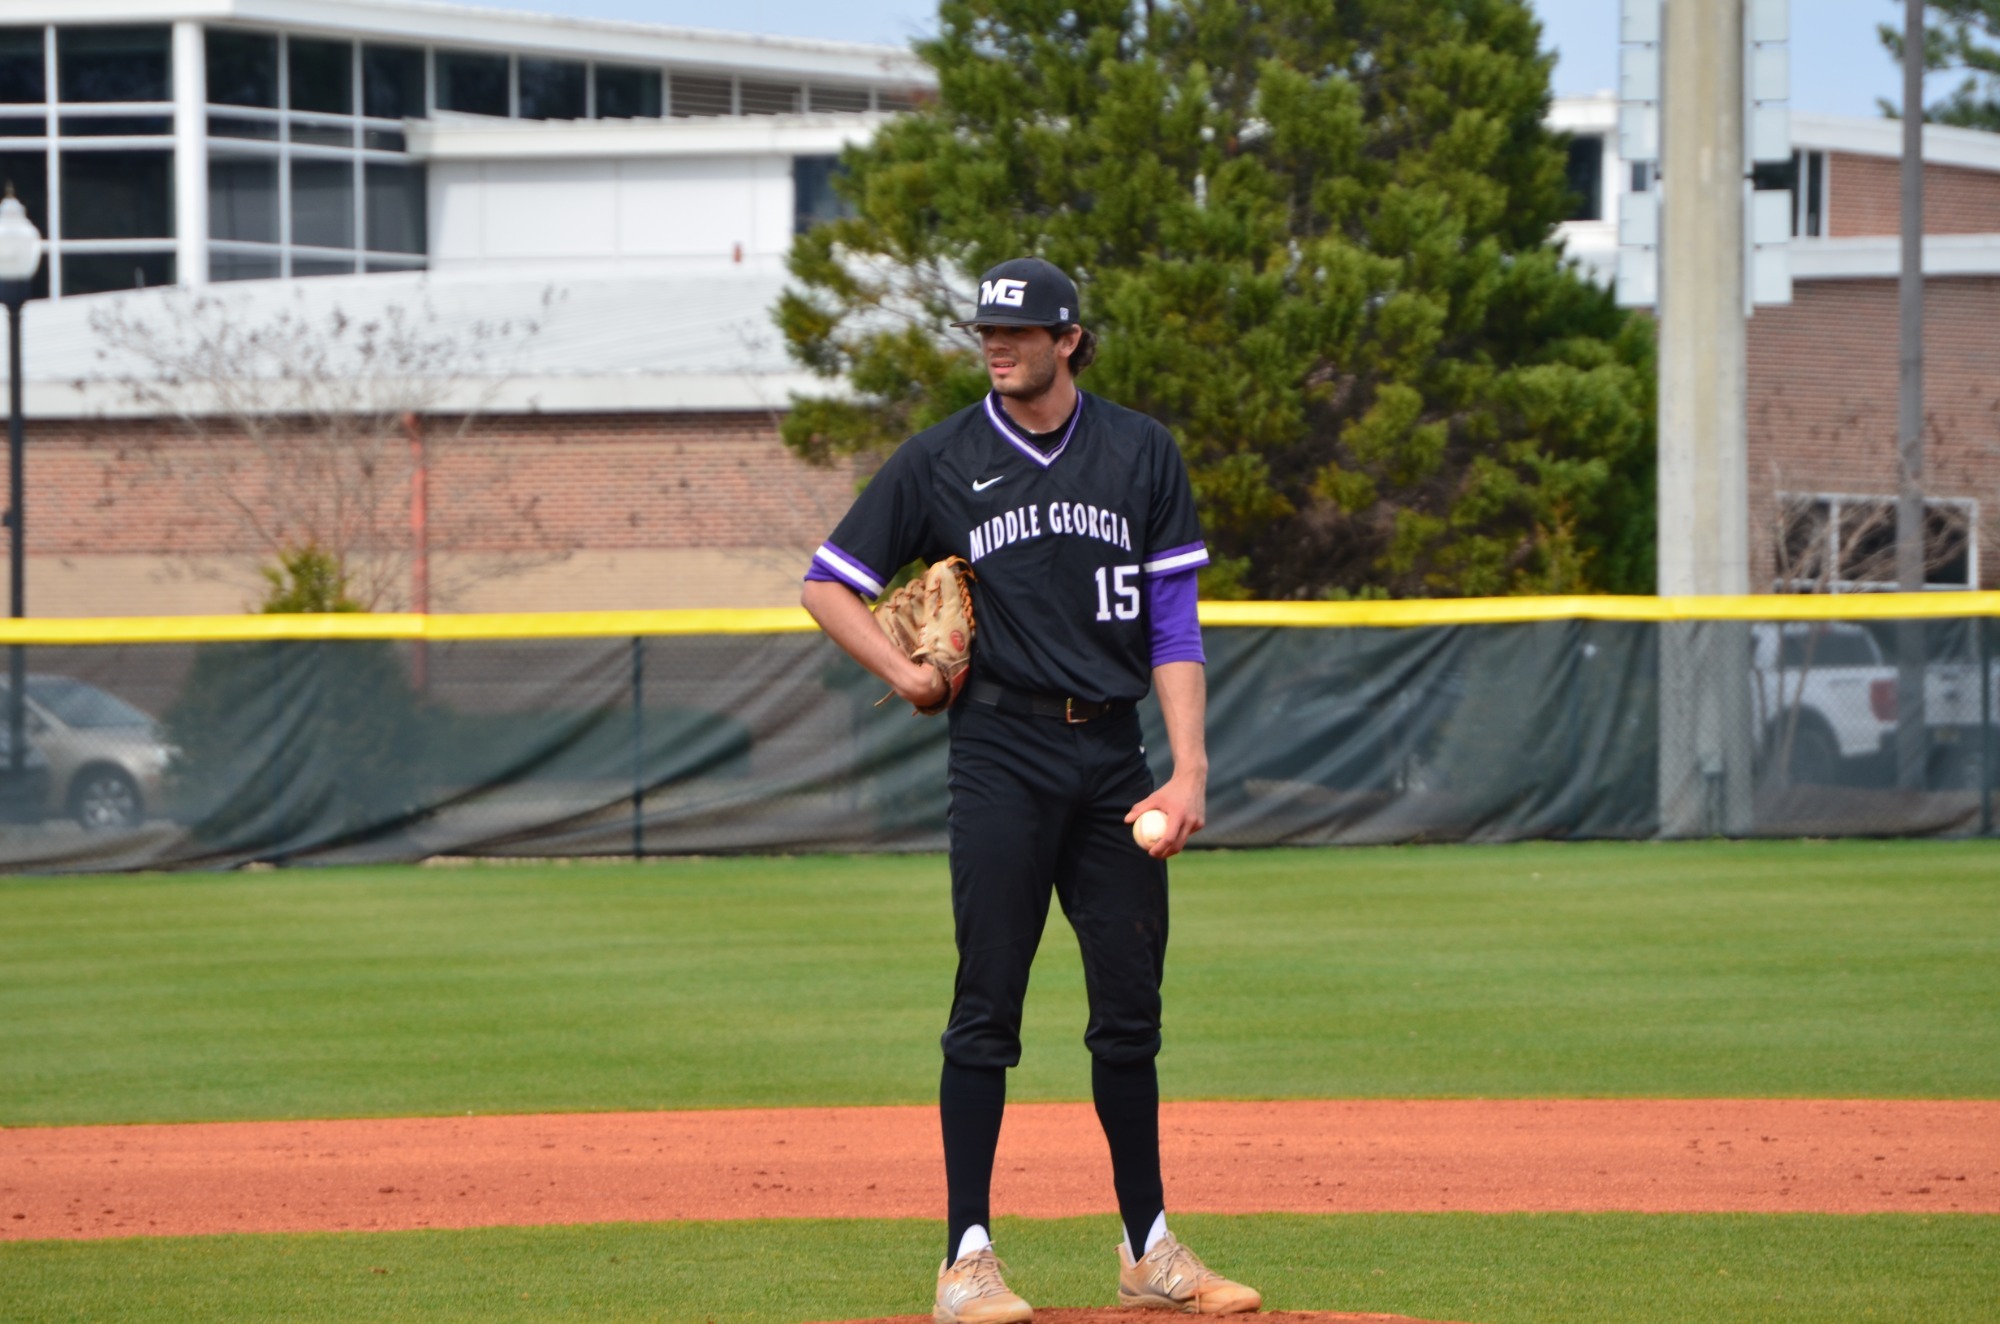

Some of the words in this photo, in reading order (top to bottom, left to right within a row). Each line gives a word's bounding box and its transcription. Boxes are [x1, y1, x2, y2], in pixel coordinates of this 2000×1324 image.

[980, 278, 1028, 307] MG
[969, 504, 1041, 563] MIDDLE
[1049, 502, 1131, 551] GEORGIA
[1095, 564, 1140, 621] 15
